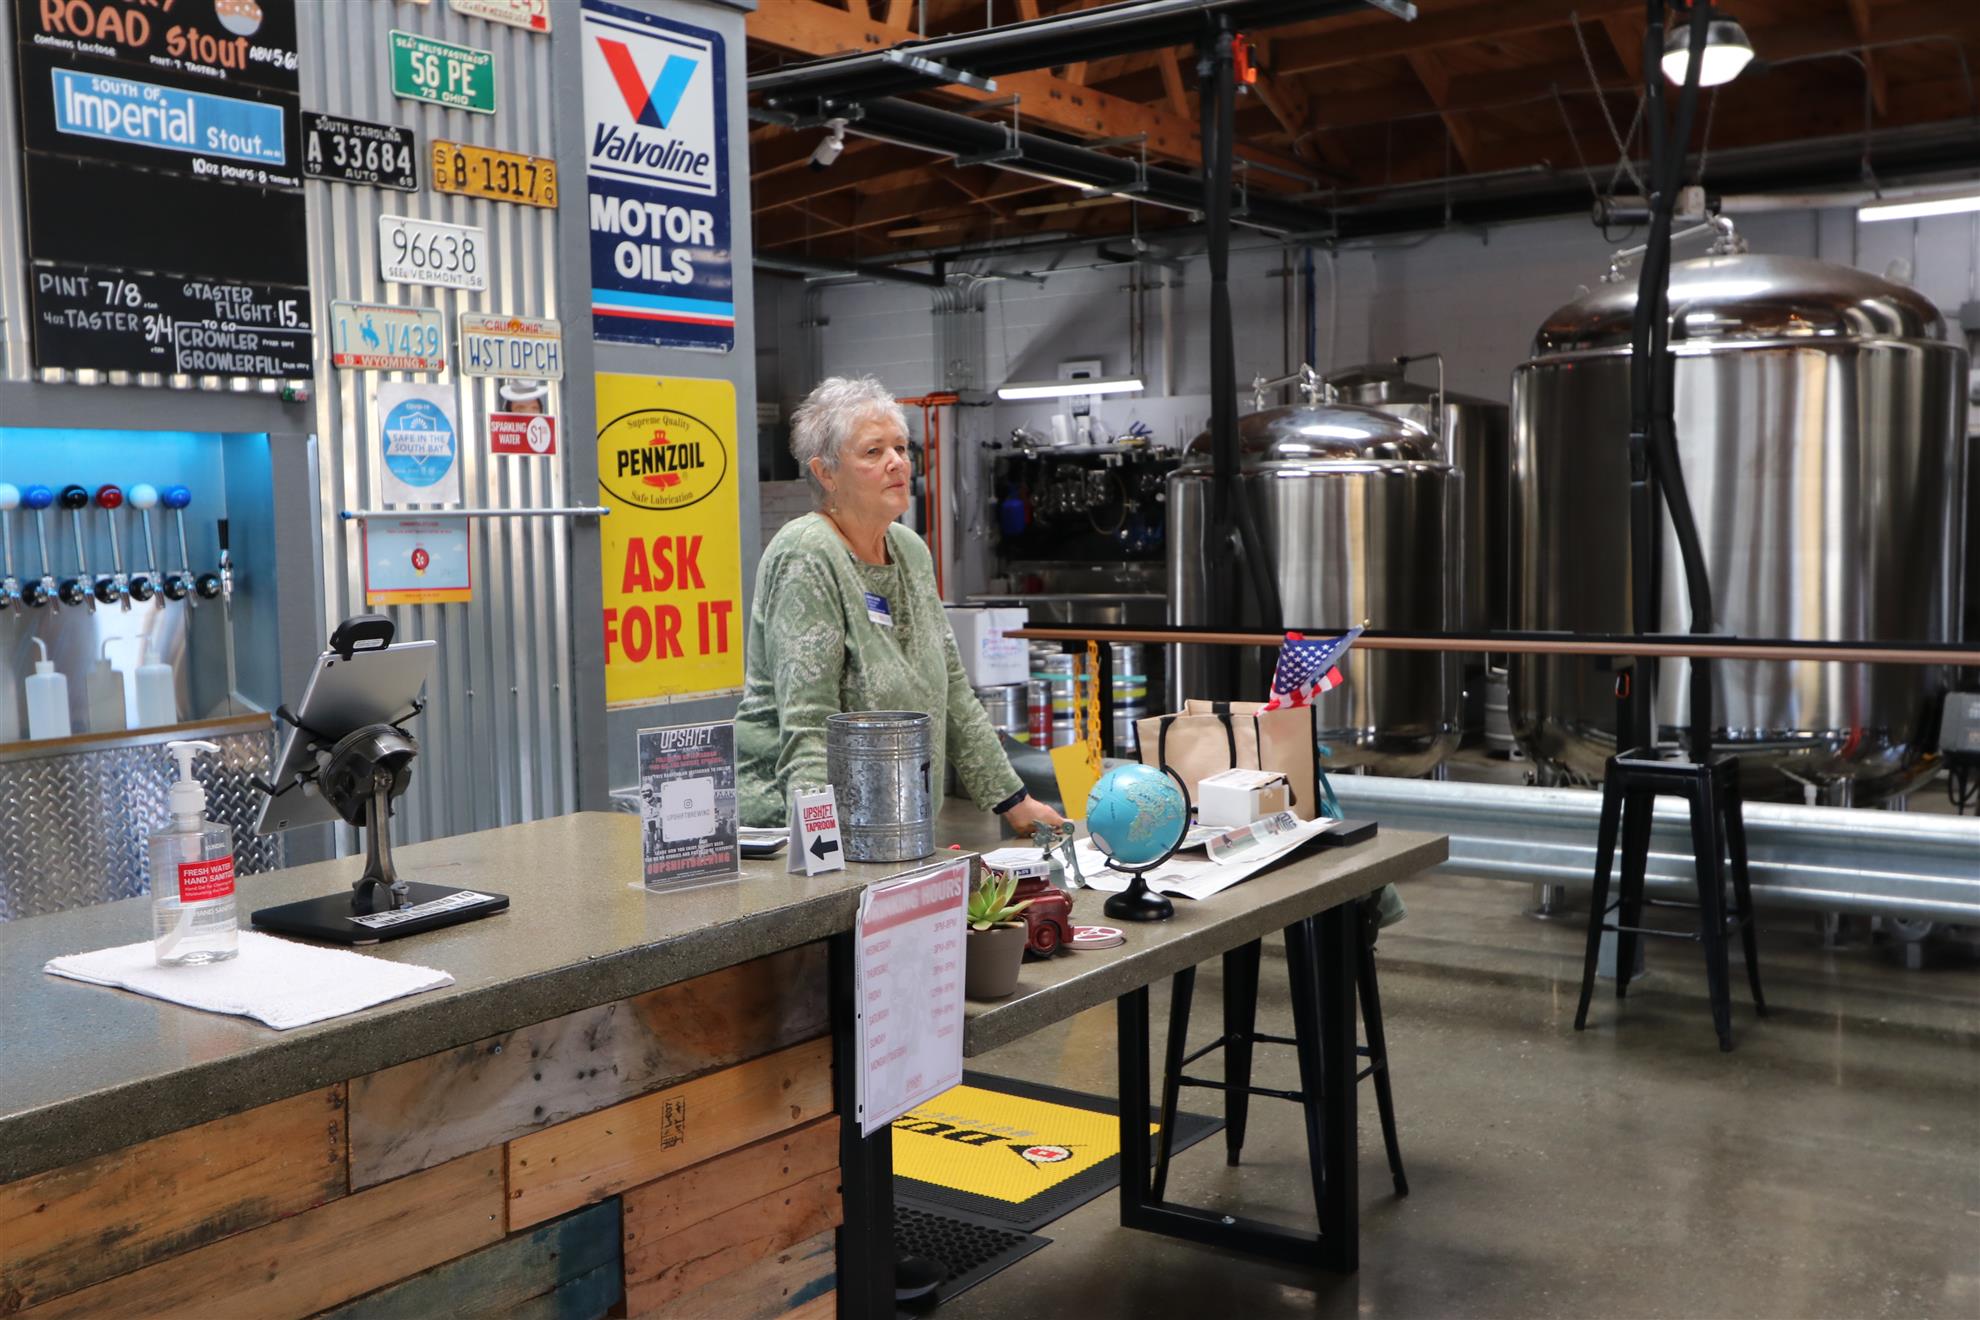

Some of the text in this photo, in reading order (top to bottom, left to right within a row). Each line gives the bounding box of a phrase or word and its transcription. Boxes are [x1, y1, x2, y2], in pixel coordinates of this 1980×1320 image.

[40, 0, 150, 47] ROAD
[411, 51, 477, 97] 56 PE
[91, 78, 160, 101] SOUTH OF
[420, 87, 469, 106] 73 OHIO
[64, 76, 196, 144] Imperial
[315, 117, 401, 142] SOUTH CAROLINA
[307, 130, 411, 176] A 33684
[592, 122, 710, 176] Valvoline
[345, 168, 379, 182] AUTO
[590, 193, 715, 246] MOTOR
[392, 228, 476, 274] 96638
[614, 241, 694, 285] OILS
[411, 269, 462, 284] VERMONT
[97, 279, 142, 307] 7/8
[278, 299, 298, 327] 15
[142, 313, 173, 344] 3/4
[201, 319, 237, 332] TO GO
[179, 328, 259, 351] CROWLER
[361, 355, 420, 369] WYOMING
[490, 420, 527, 434] SPARKLING
[627, 415, 690, 431] Supreme Quality
[393, 433, 446, 444] SAFE IN THE
[394, 443, 444, 453] SOUTH BAY
[498, 433, 521, 446] WATER
[617, 442, 705, 478] PENNZOIL
[632, 490, 694, 505] Safe Lubrication
[622, 535, 705, 594] ASK
[604, 600, 733, 665] FOR IT
[661, 727, 714, 750] UPSHIFT
[803, 804, 833, 820] UPSHIFT
[805, 819, 836, 832] TAPROOM
[183, 868, 209, 878] FRESH
[184, 876, 208, 886] HAND
[921, 878, 961, 906] HOURS
